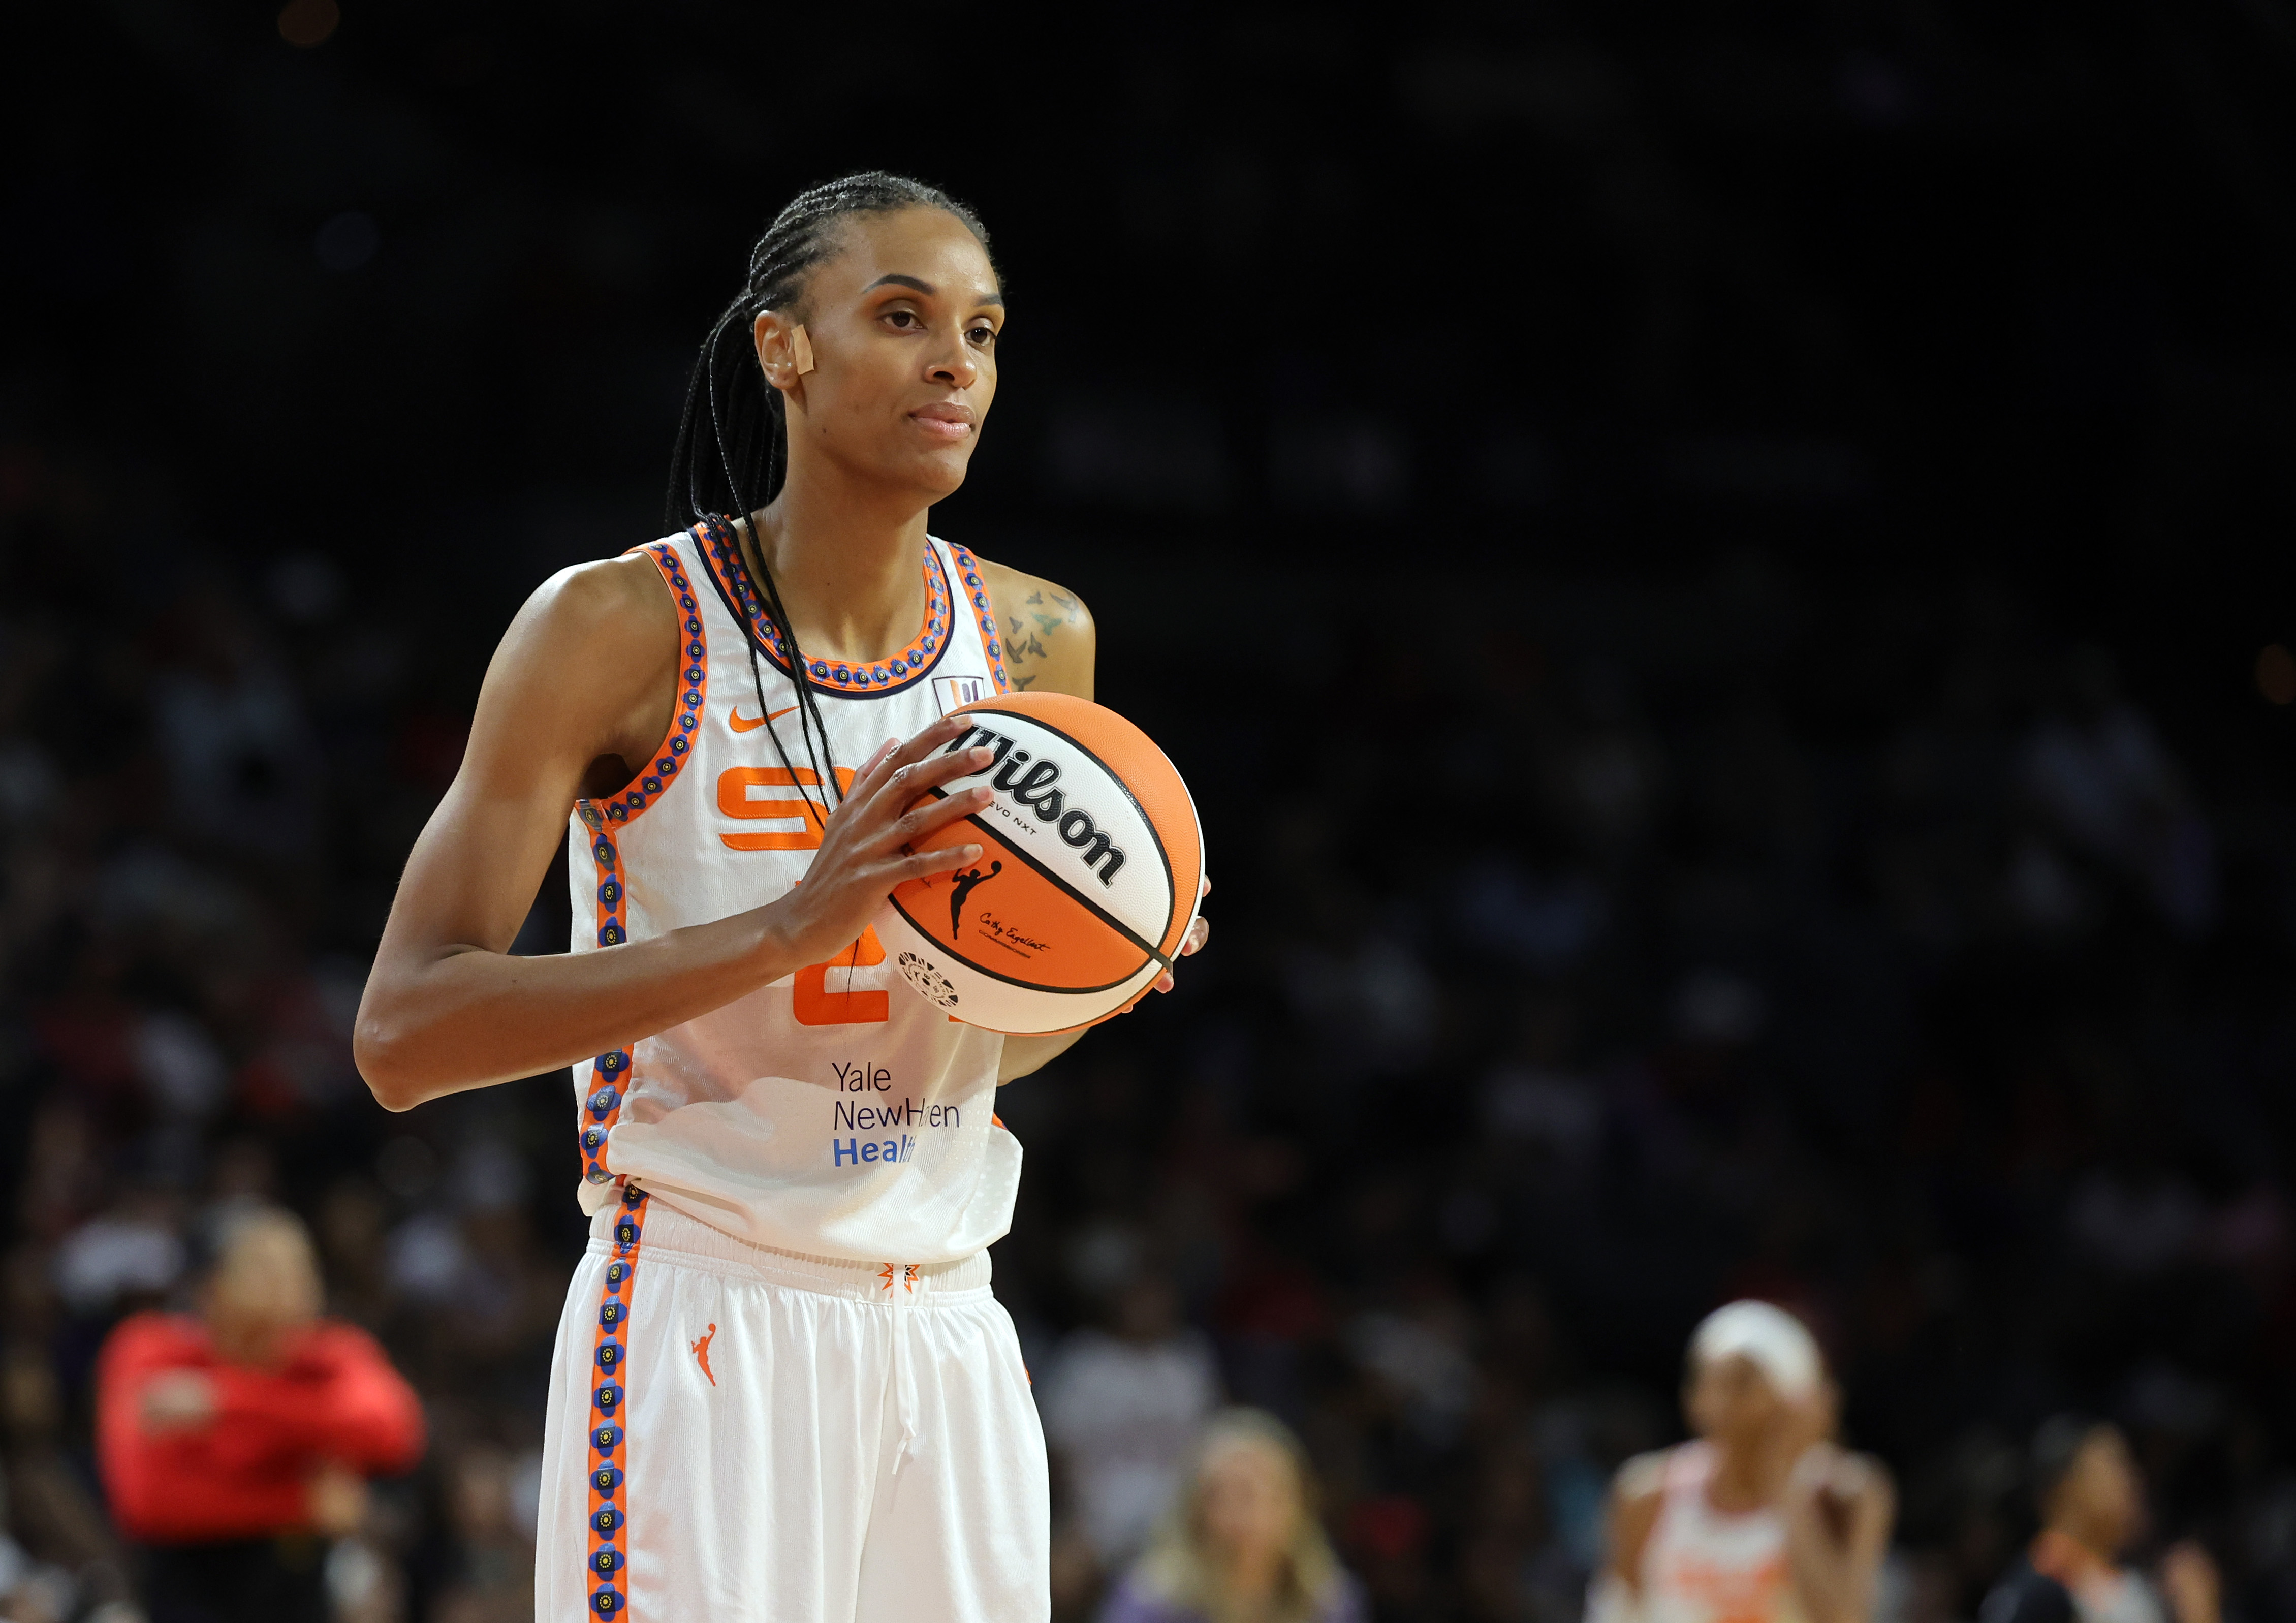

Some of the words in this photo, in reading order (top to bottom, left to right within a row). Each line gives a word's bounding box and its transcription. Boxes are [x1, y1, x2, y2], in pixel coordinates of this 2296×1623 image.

[944, 724, 1126, 889] Wilson
[1013, 817, 1036, 835] NXT
[832, 1062, 891, 1093] Yale
